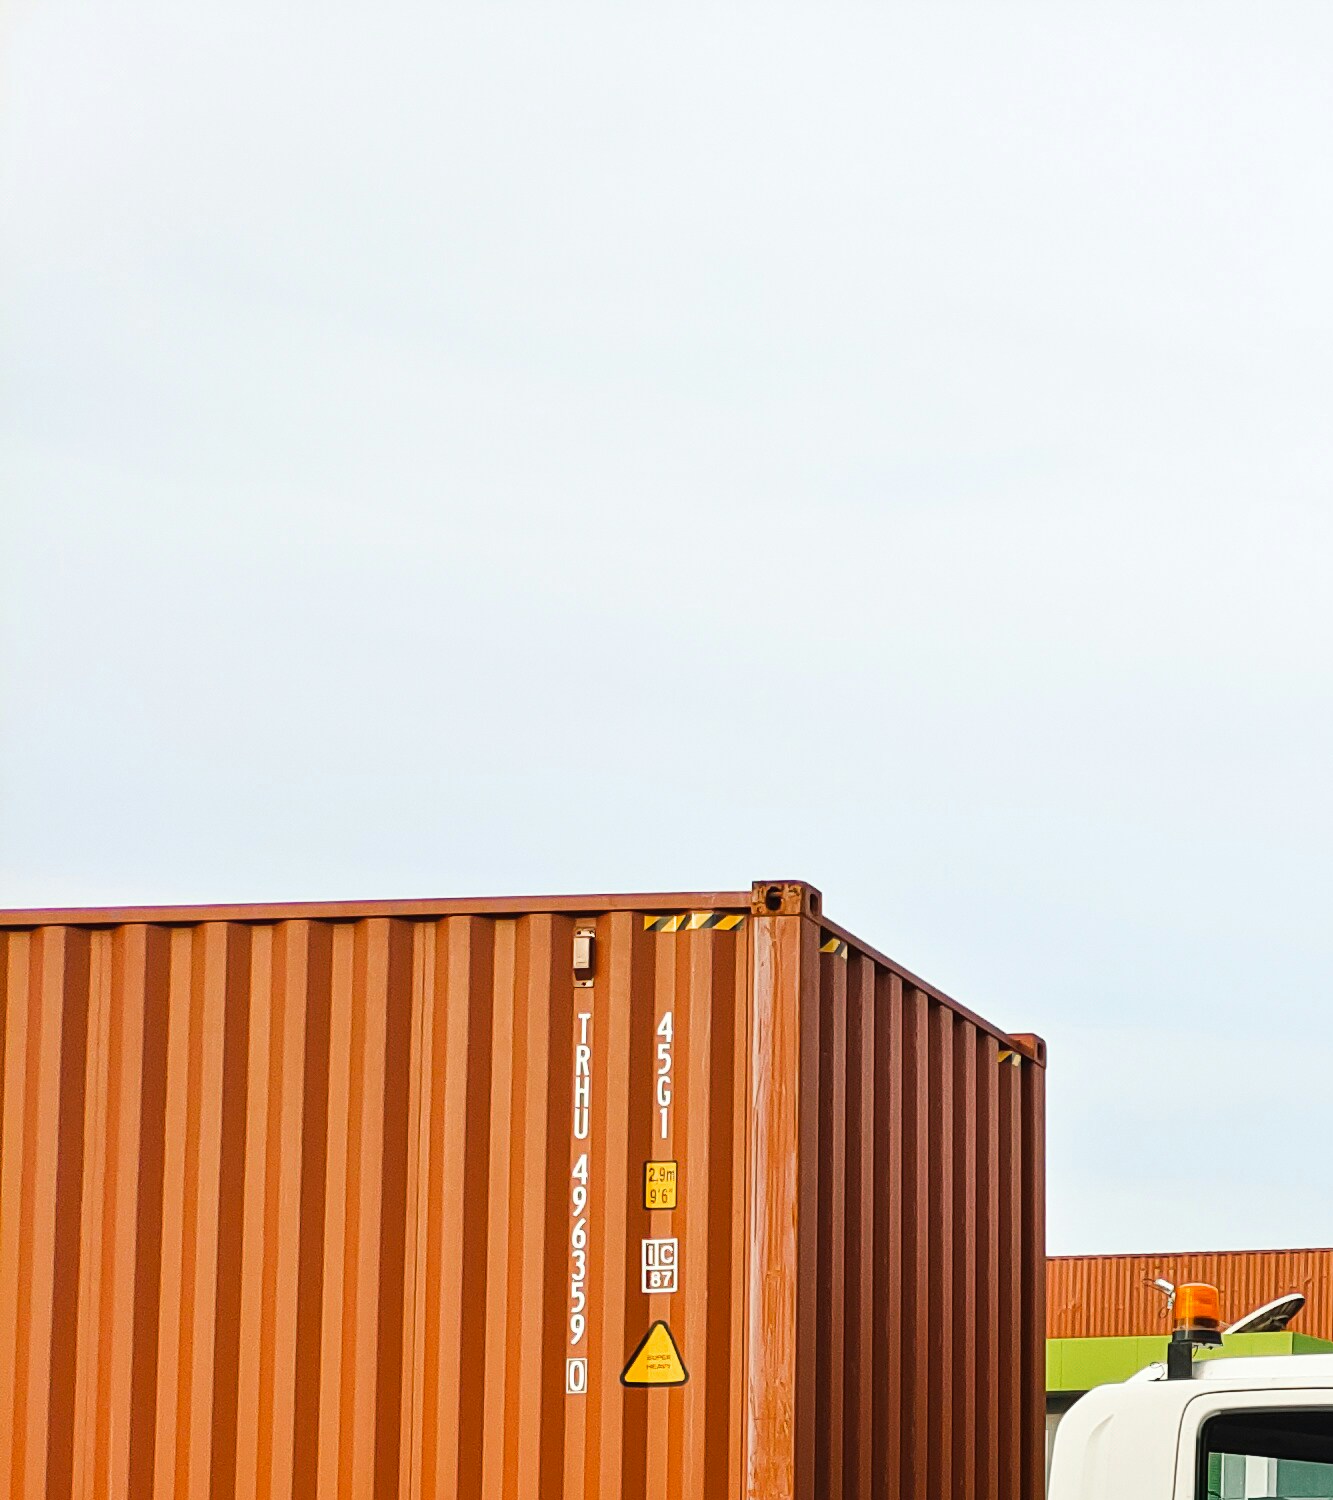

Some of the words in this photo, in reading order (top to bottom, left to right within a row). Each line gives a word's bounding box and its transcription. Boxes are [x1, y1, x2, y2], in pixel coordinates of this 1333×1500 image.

[573, 1012, 592, 1140] TRHU
[656, 1011, 674, 1140] 45G1
[570, 1153, 588, 1346] 496359
[649, 1270, 673, 1288] 87
[569, 1359, 586, 1392] 0
